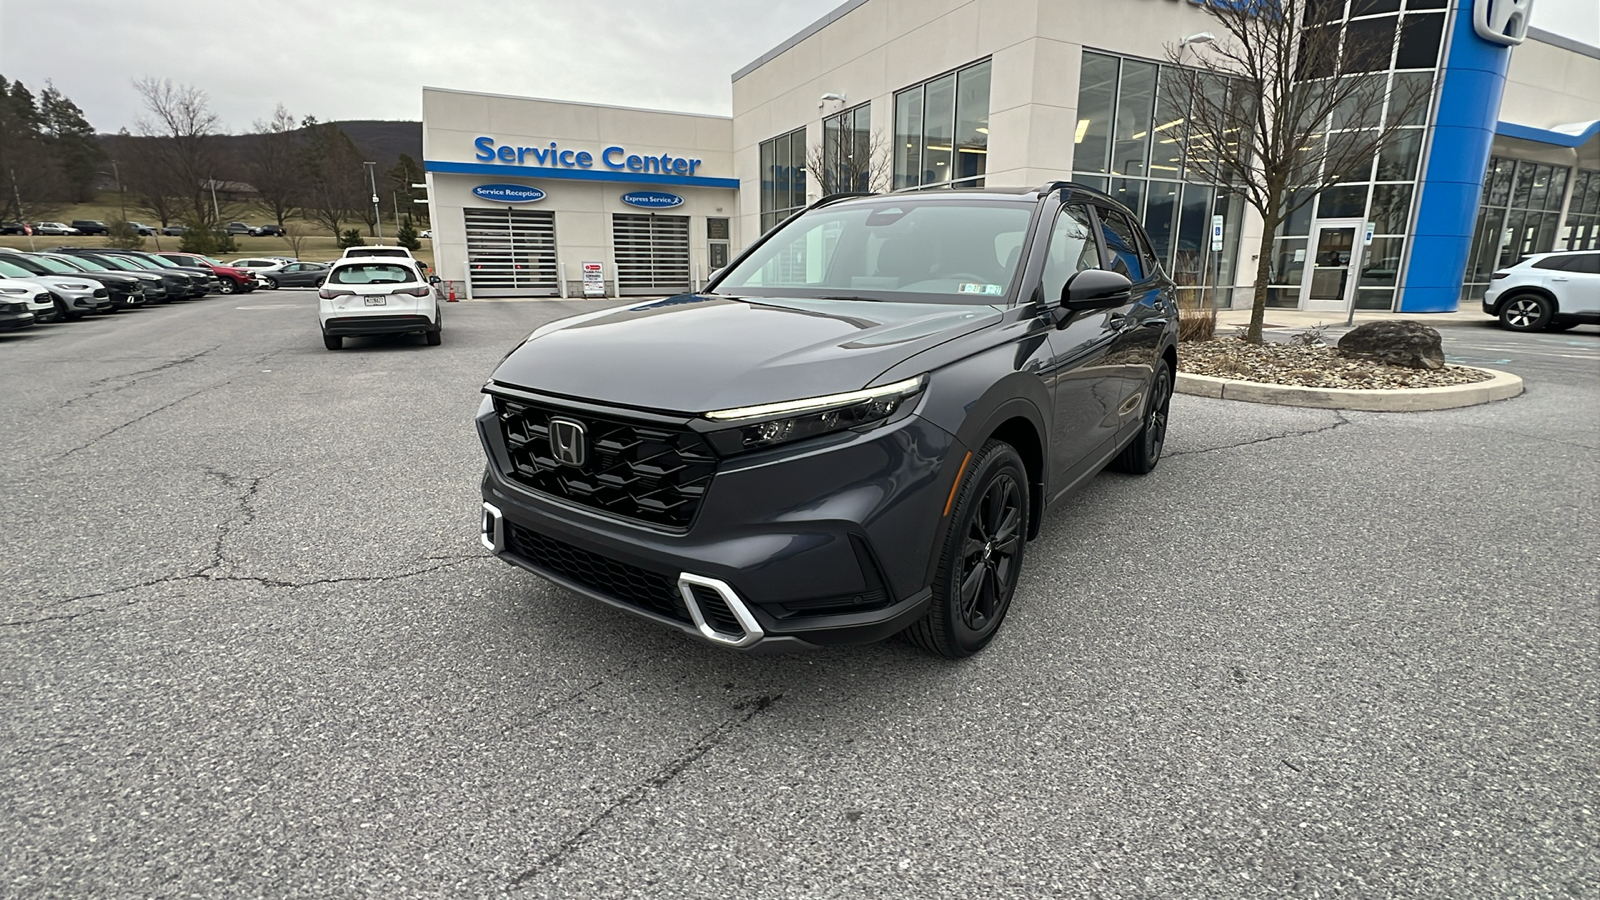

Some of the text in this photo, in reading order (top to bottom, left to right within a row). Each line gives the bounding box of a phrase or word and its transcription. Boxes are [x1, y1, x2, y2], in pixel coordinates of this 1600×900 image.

[474, 136, 702, 175] Service Center
[477, 187, 541, 198] Service Reception
[625, 195, 648, 203] Express
